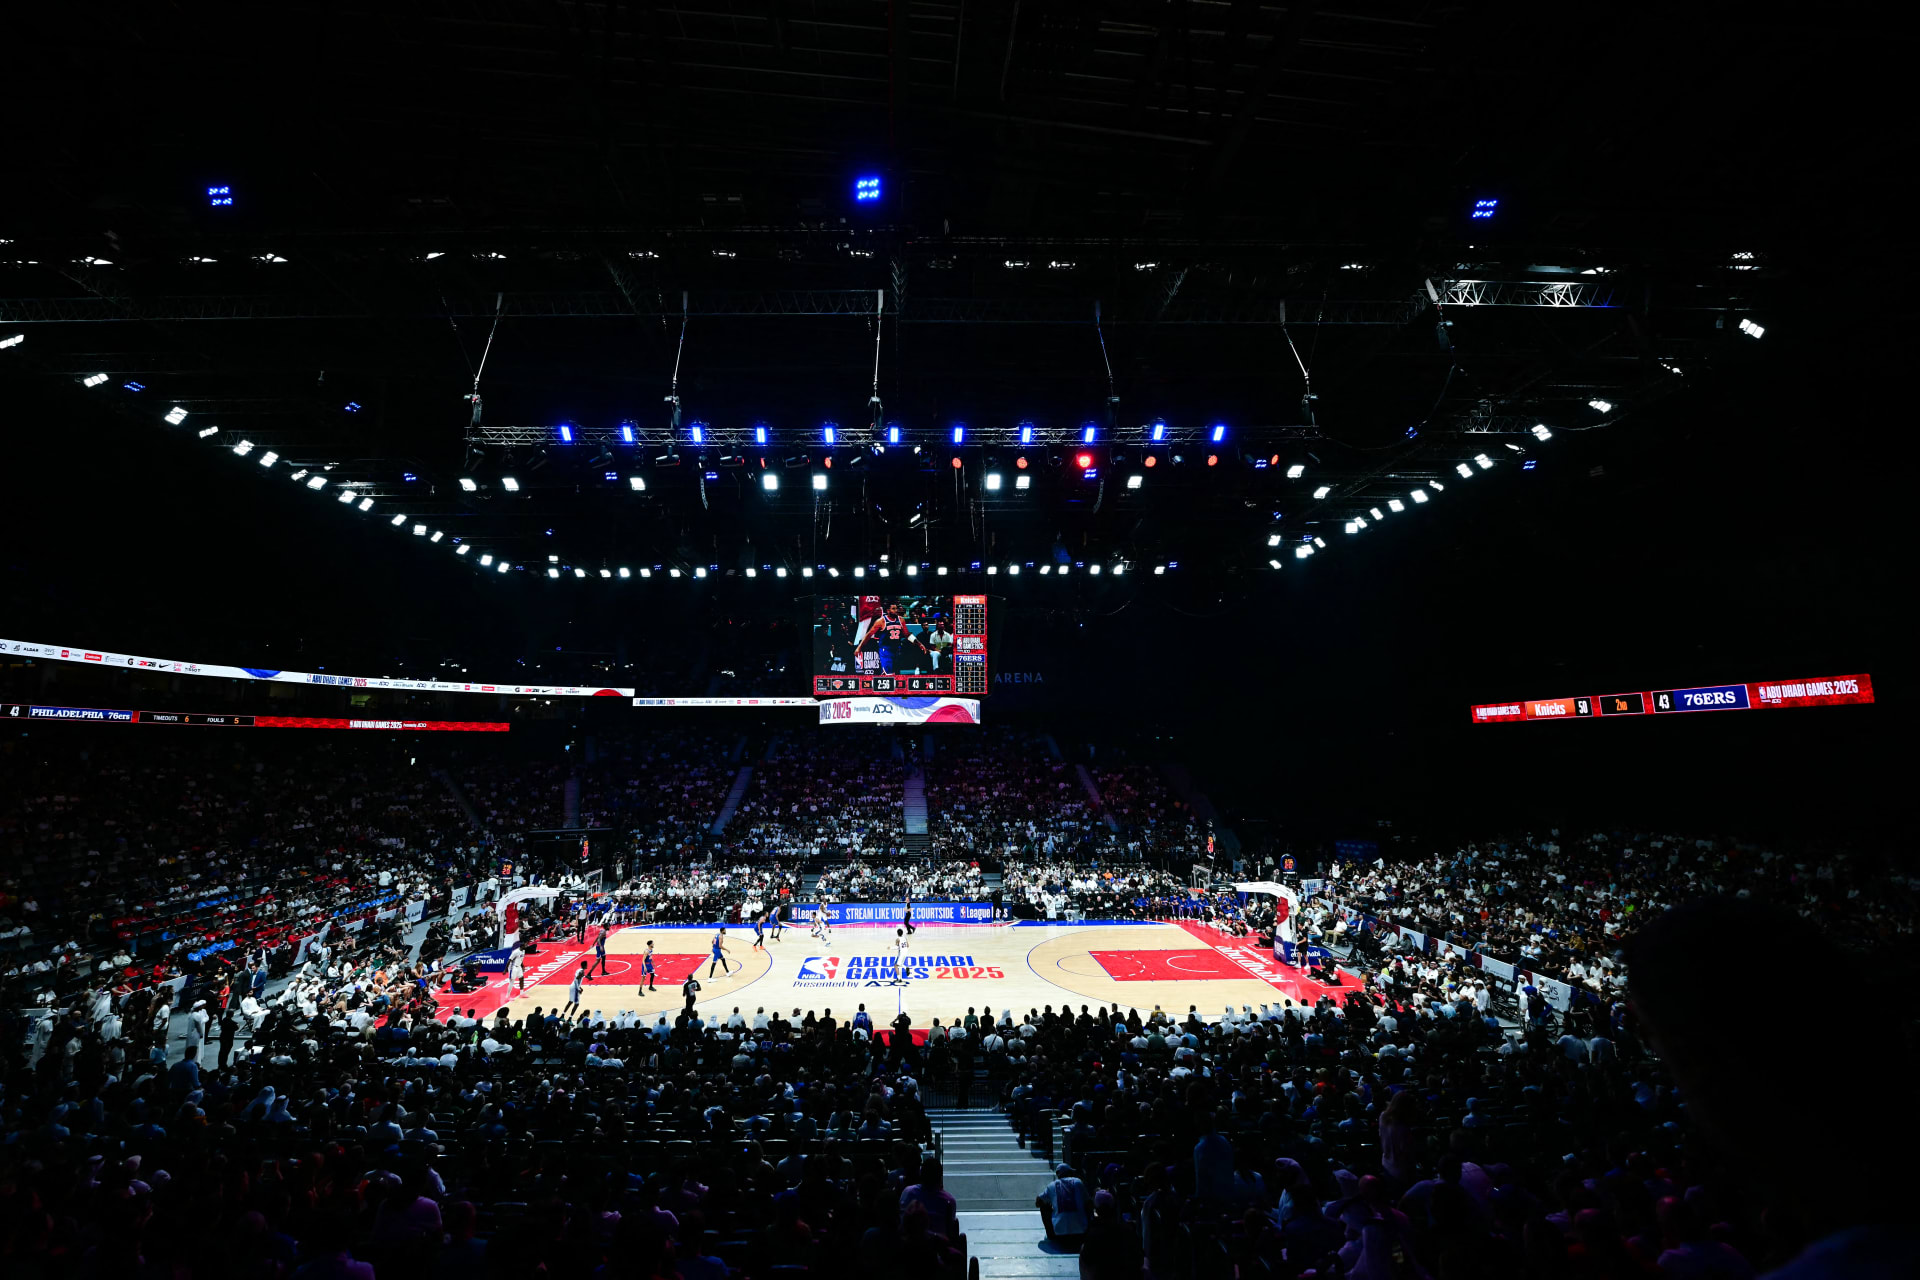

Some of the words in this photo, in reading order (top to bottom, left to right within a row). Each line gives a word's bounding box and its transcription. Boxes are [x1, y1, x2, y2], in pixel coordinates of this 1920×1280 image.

[890, 630, 900, 639] 32
[995, 672, 1043, 683] ARENA
[848, 680, 855, 689] 50
[912, 680, 920, 688] 43
[1766, 686, 1782, 699] ABU
[1782, 684, 1806, 698] DHABI
[1806, 681, 1833, 697] GAMES
[1834, 680, 1859, 694] 2025
[1659, 694, 1670, 709] 43
[1684, 691, 1736, 706] 76ERS
[9, 706, 20, 717] 43
[833, 701, 851, 719] 2025
[872, 704, 893, 714] ADQ
[1535, 702, 1566, 716] Knicks
[1578, 700, 1588, 714] 50
[31, 708, 104, 719] PHILADELPHIA
[108, 712, 130, 720] 76ers
[846, 908, 873, 919] STREAM
[875, 908, 890, 919] LIKE
[916, 907, 954, 919] COURTSIDE
[967, 907, 991, 920] League
[847, 956, 896, 967] ABU
[903, 956, 975, 967] DHABI
[846, 967, 930, 979] GAMES
[935, 967, 1004, 979] 2025
